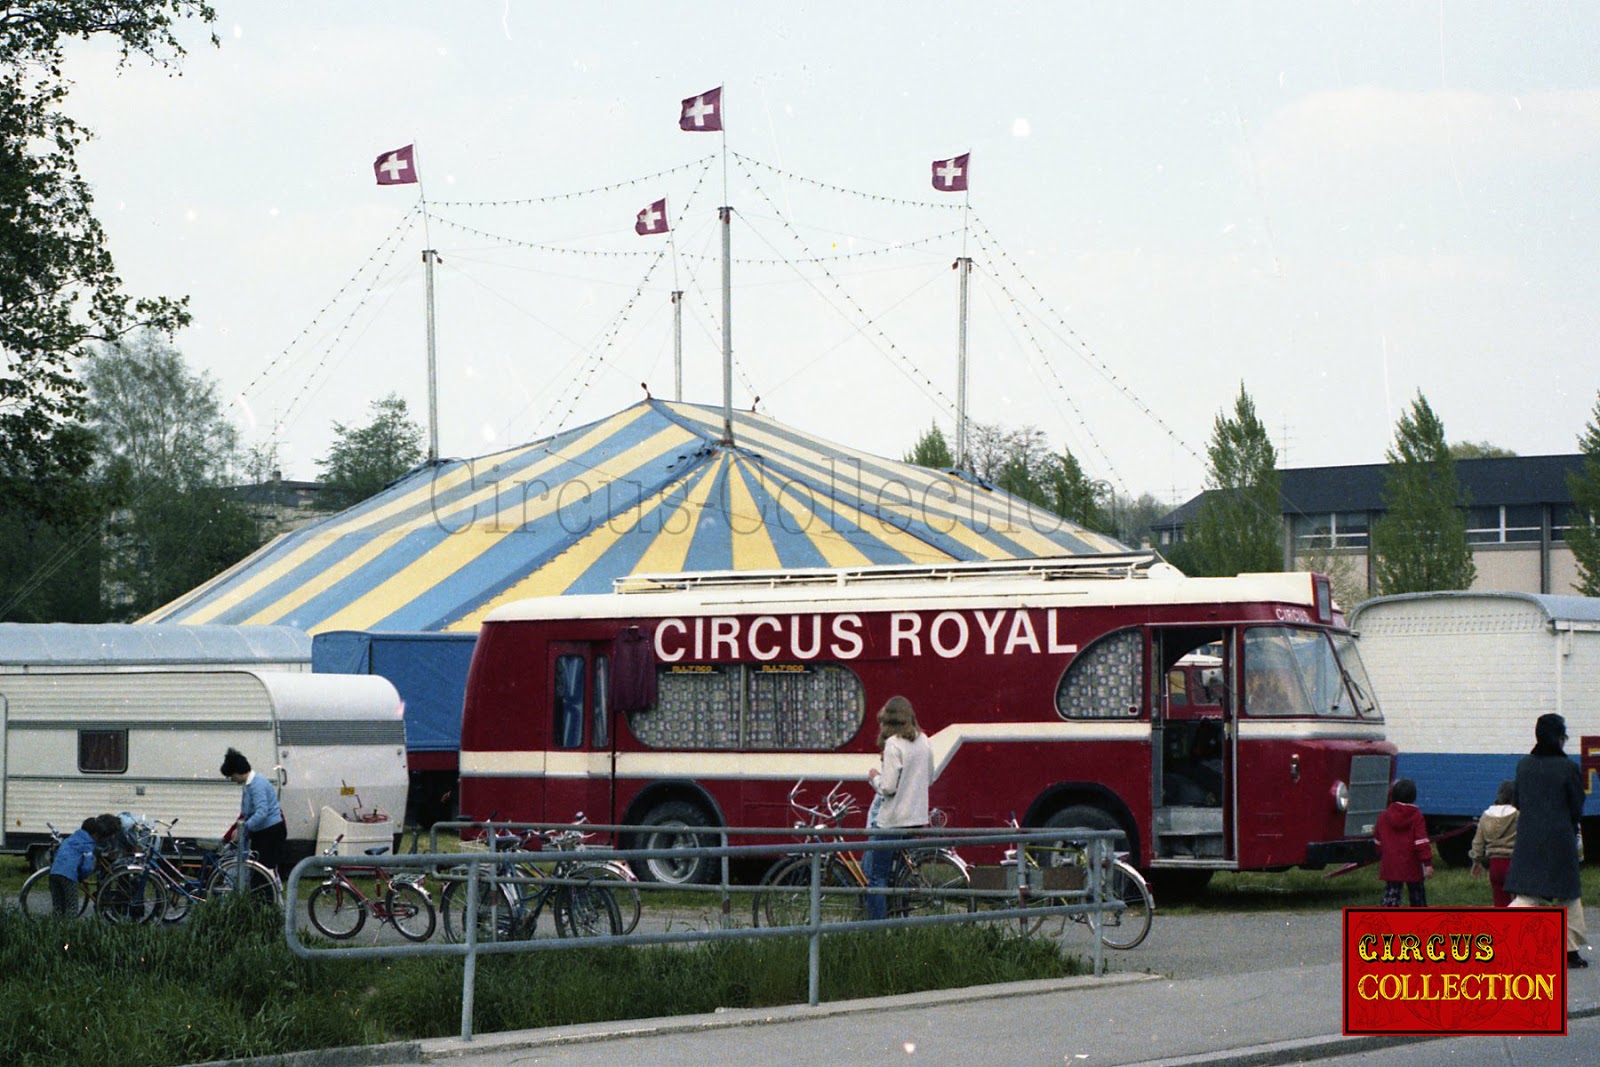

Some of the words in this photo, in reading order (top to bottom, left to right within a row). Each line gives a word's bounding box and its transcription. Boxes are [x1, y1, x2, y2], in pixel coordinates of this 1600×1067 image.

[1275, 608, 1311, 623] CIRCUS
[654, 613, 865, 662] CIRCUS
[889, 608, 1078, 658] ROYAL
